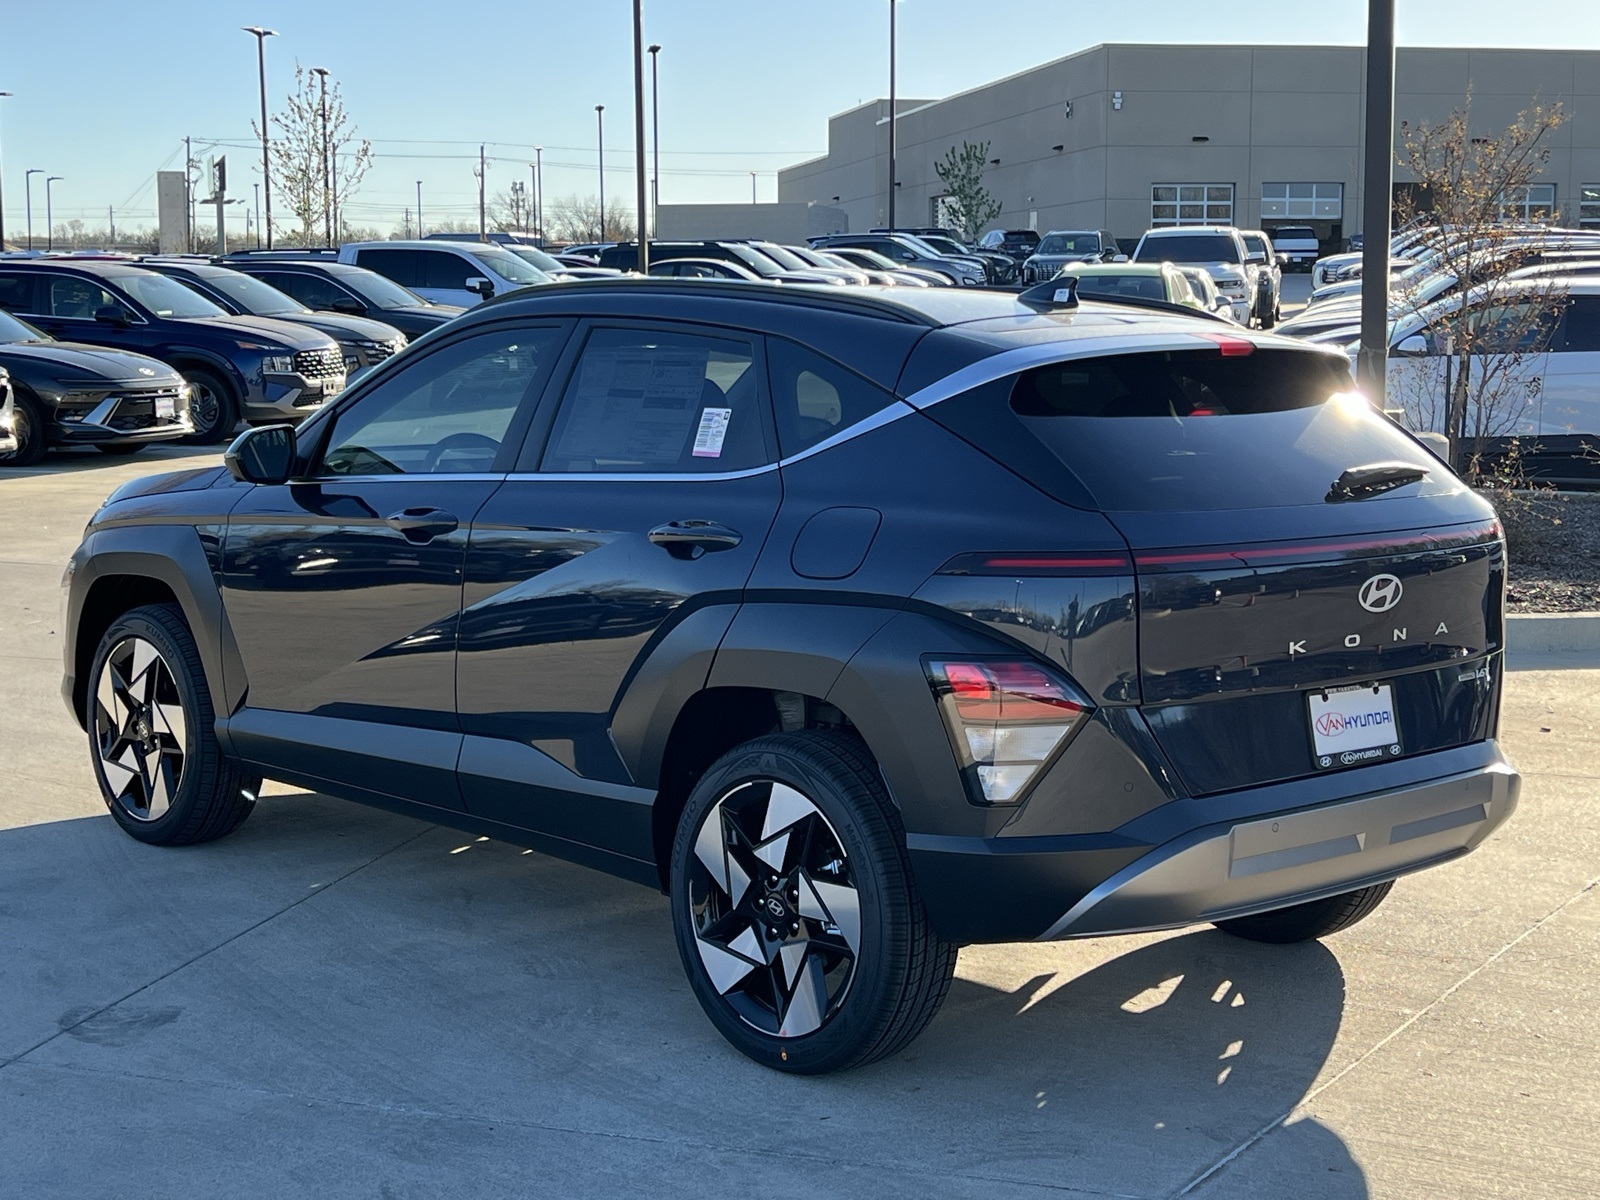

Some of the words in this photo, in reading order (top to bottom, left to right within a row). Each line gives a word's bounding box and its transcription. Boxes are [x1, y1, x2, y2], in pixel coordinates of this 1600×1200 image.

[145, 624, 174, 659] KUMHO
[1289, 622, 1448, 655] KONA
[1344, 710, 1393, 730] HYUNDAI
